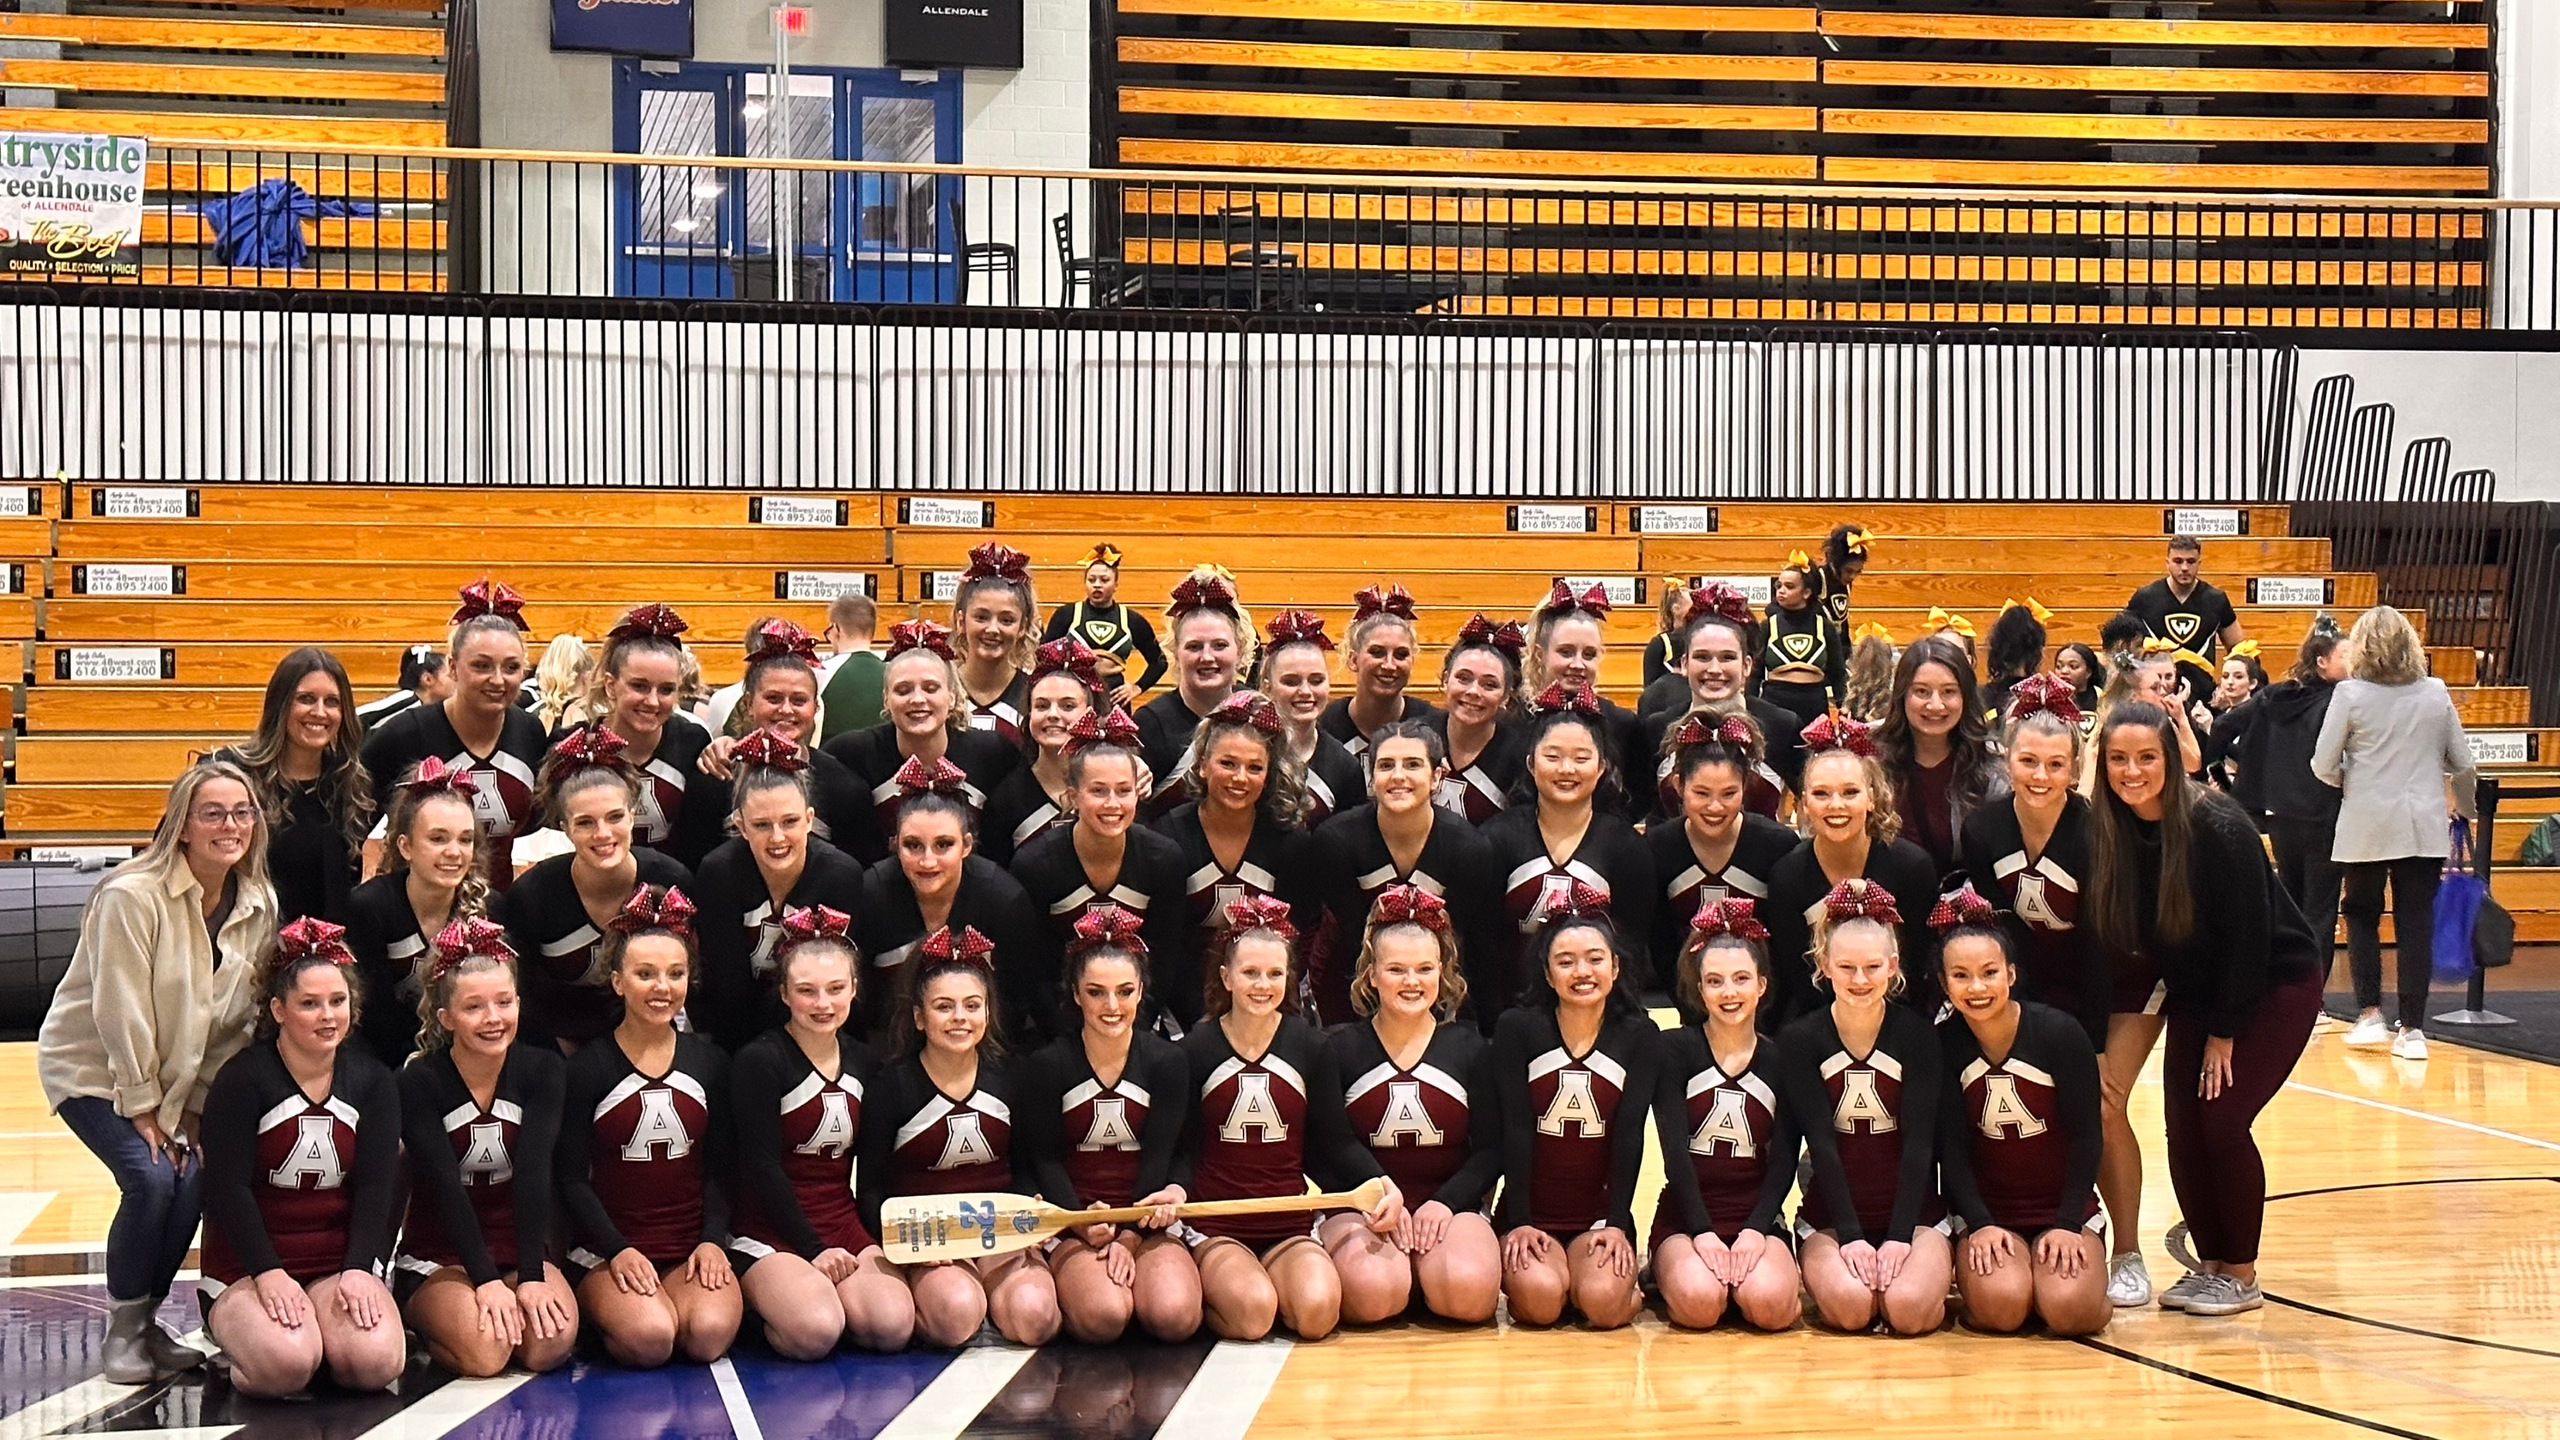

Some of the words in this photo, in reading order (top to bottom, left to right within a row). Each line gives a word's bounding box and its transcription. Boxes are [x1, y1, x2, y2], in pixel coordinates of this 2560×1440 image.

[922, 5, 989, 17] ALLENDALE
[0, 133, 140, 179] tryside
[34, 202, 94, 213] ALLENDALE
[47, 222, 131, 258] Best
[9, 260, 47, 271] QUALITY
[55, 261, 103, 274] SELECTION
[111, 263, 138, 275] PRICE
[2013, 873, 2075, 931] A
[621, 1088, 695, 1162] A
[793, 1090, 855, 1159] A
[1077, 1098, 1141, 1152] A
[1220, 1072, 1289, 1143] A
[1369, 1081, 1444, 1148] A
[1537, 1069, 1606, 1139] A
[1688, 1088, 1757, 1158] A
[1833, 1069, 1898, 1135] A
[1977, 1074, 2049, 1140] A
[269, 1115, 347, 1190] A
[459, 1122, 513, 1186] A
[927, 1112, 999, 1171] A
